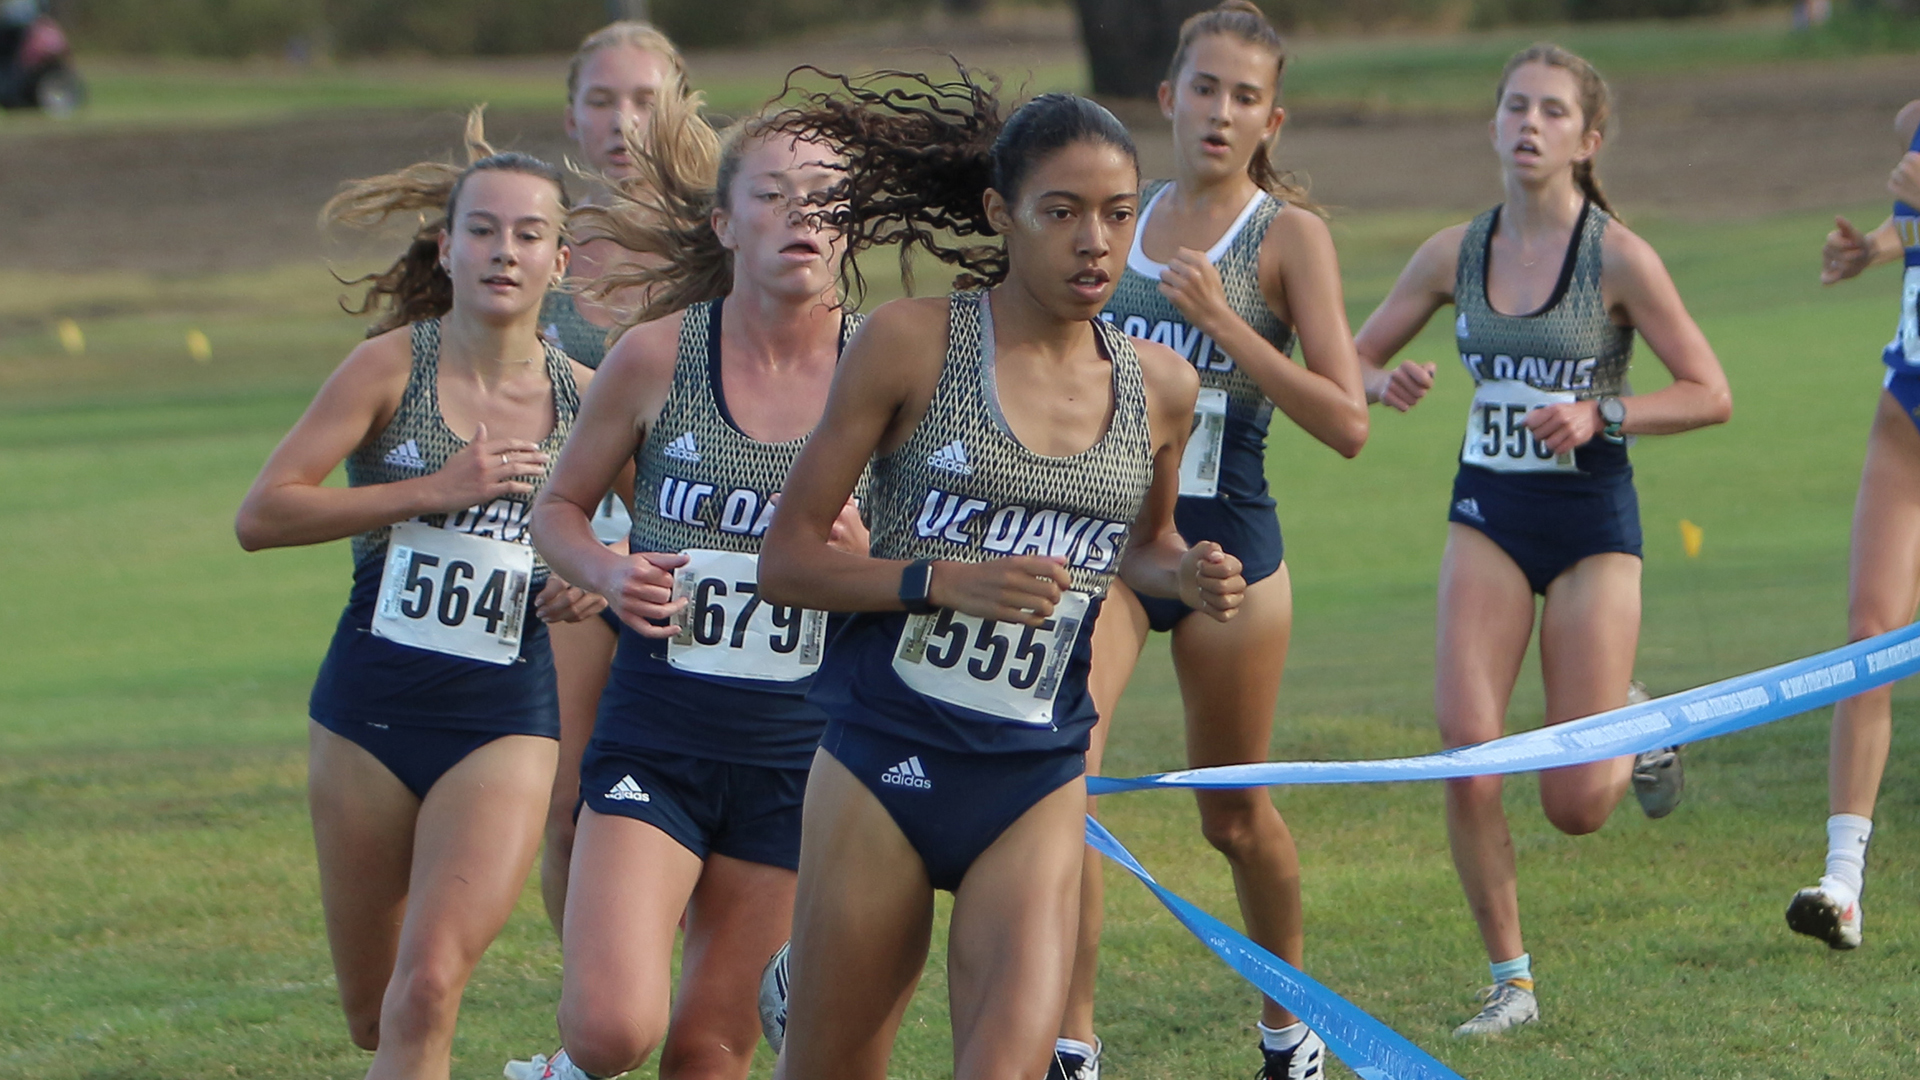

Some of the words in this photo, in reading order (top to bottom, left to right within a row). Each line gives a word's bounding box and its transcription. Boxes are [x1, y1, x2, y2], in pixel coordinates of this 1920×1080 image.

[1493, 354, 1597, 390] DAVIS
[664, 446, 700, 462] adidas
[927, 456, 972, 475] adidas
[660, 477, 714, 527] UC
[916, 490, 988, 543] UC
[982, 505, 1126, 571] DAVIS
[401, 551, 508, 634] 564
[694, 578, 803, 653] 679
[926, 607, 1057, 690] 555
[881, 773, 931, 789] adidas
